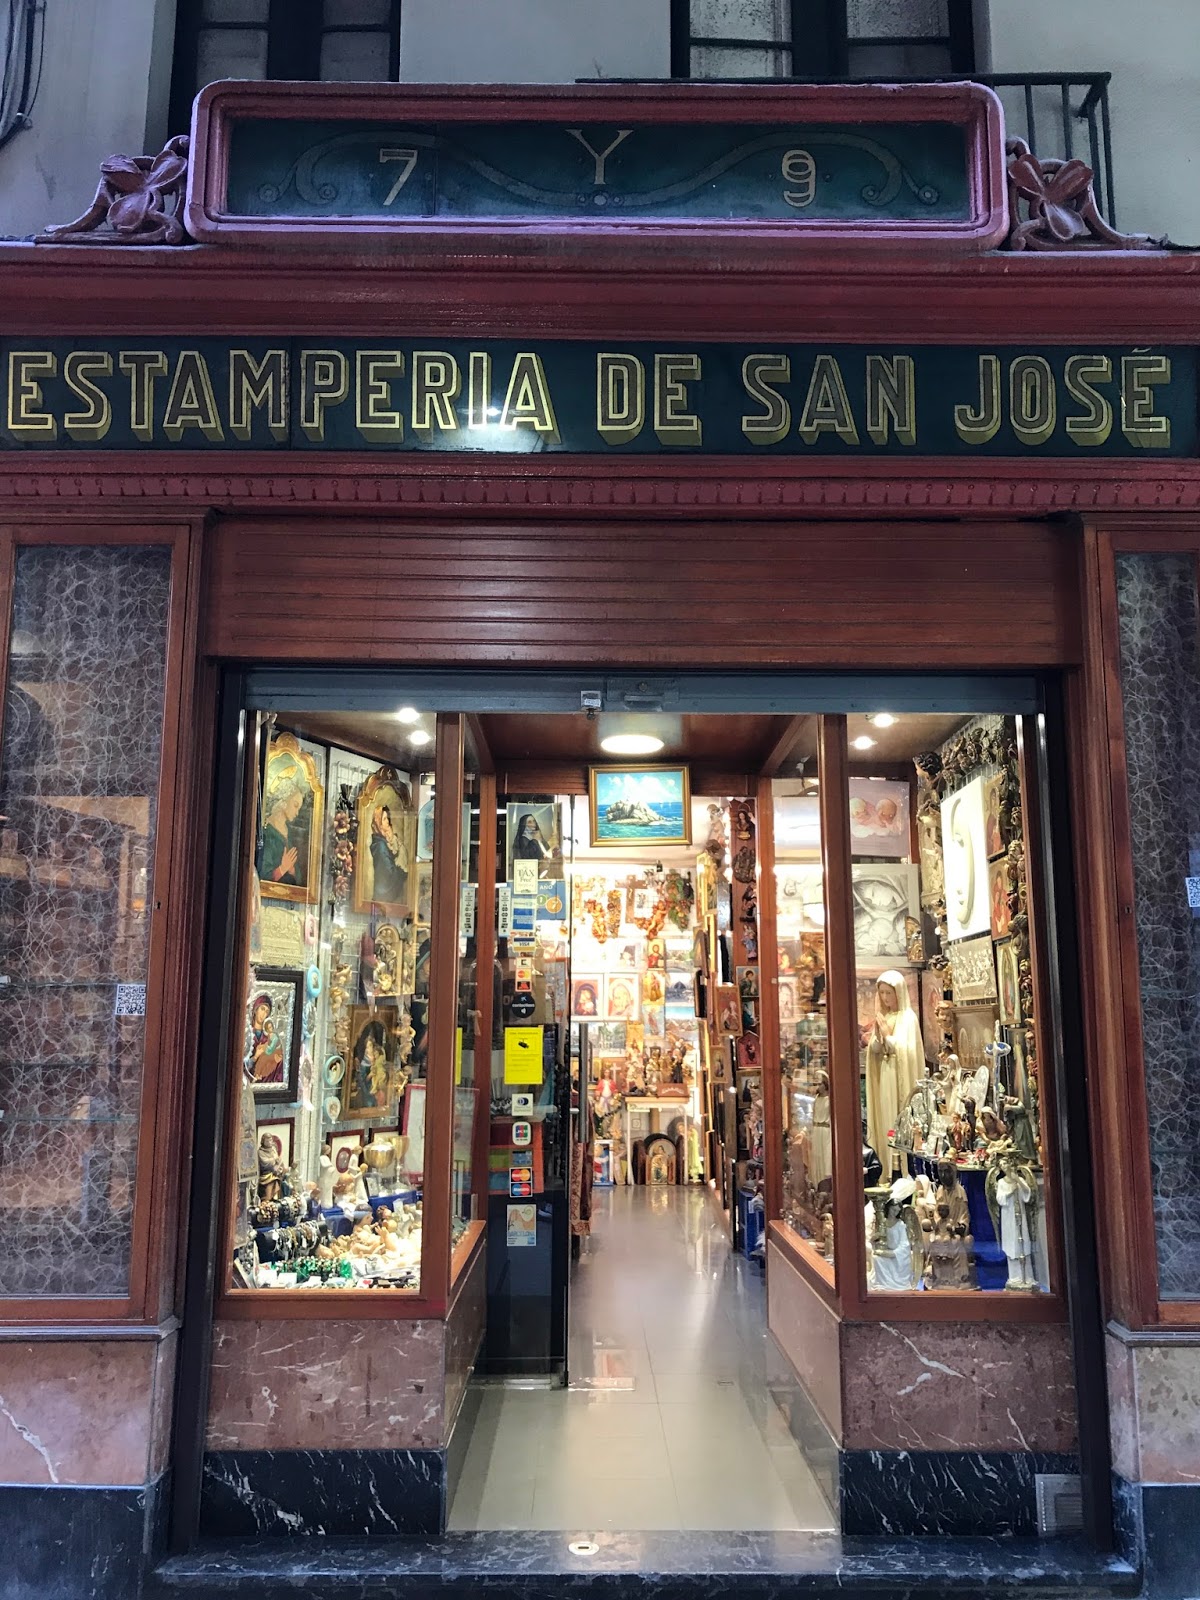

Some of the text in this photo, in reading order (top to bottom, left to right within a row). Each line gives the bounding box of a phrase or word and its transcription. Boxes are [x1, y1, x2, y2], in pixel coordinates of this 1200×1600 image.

[378, 128, 817, 208] 7 Y 9
[7, 350, 561, 443] ESTAMPERIA
[595, 352, 703, 446] DE
[741, 353, 918, 446] SAN
[518, 869, 535, 877] TAX
